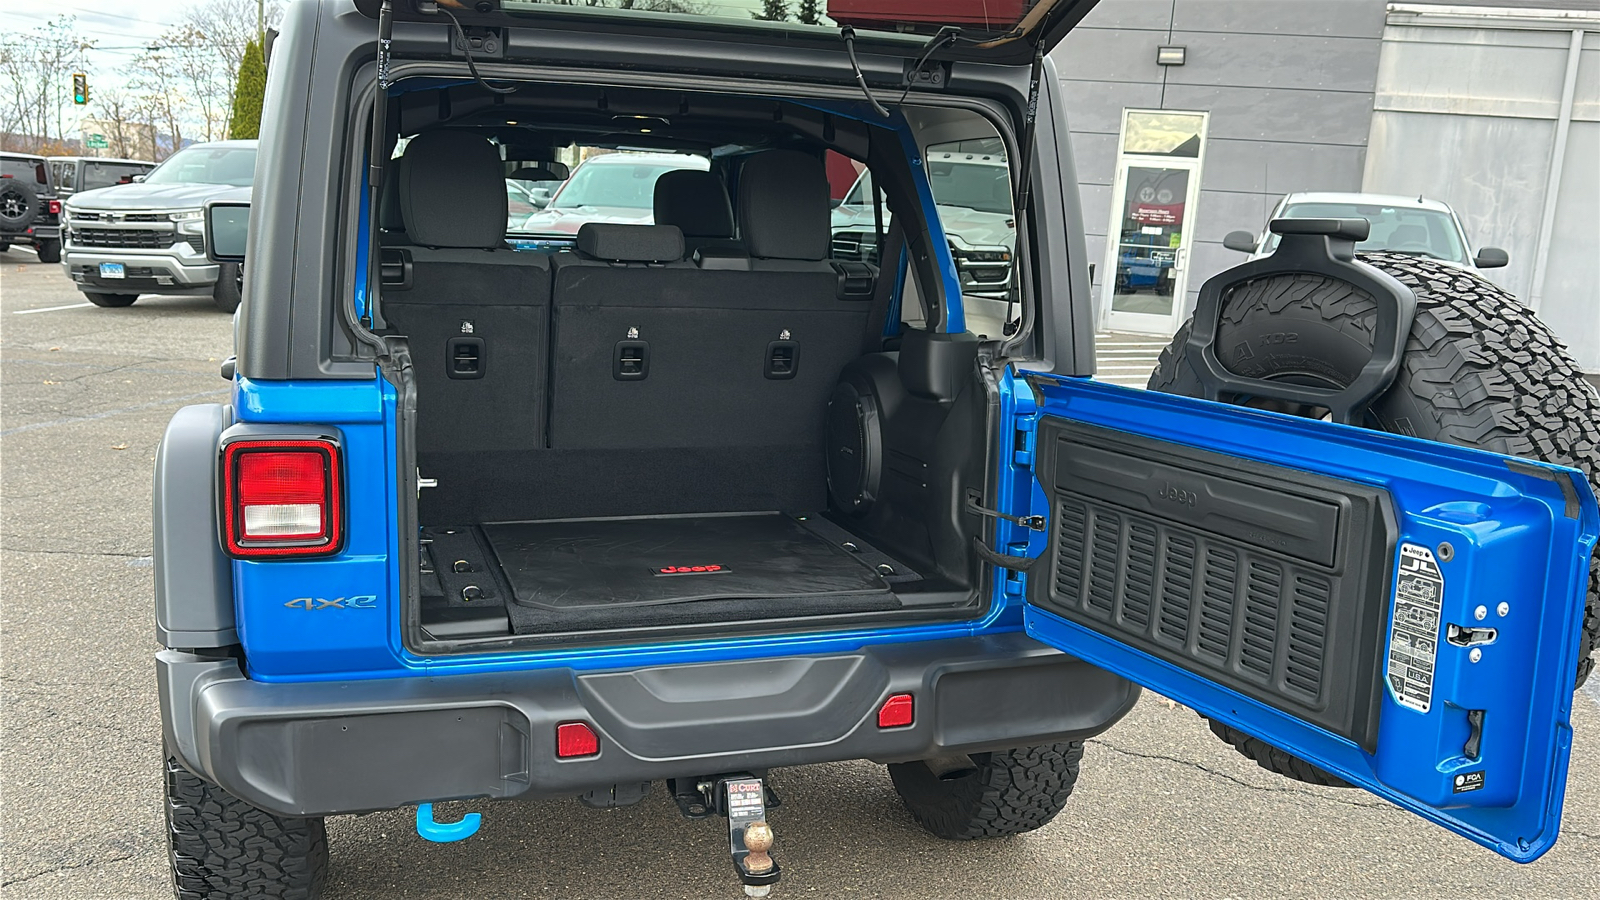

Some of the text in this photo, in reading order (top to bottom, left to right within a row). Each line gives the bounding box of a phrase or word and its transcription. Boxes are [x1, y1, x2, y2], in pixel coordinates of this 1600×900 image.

[1158, 481, 1198, 509] Jeep
[1408, 546, 1424, 557] Jeep
[660, 564, 722, 573] Jeep
[1401, 559, 1437, 574] JL
[1466, 773, 1481, 782] FCA
[738, 783, 760, 792] CURT
